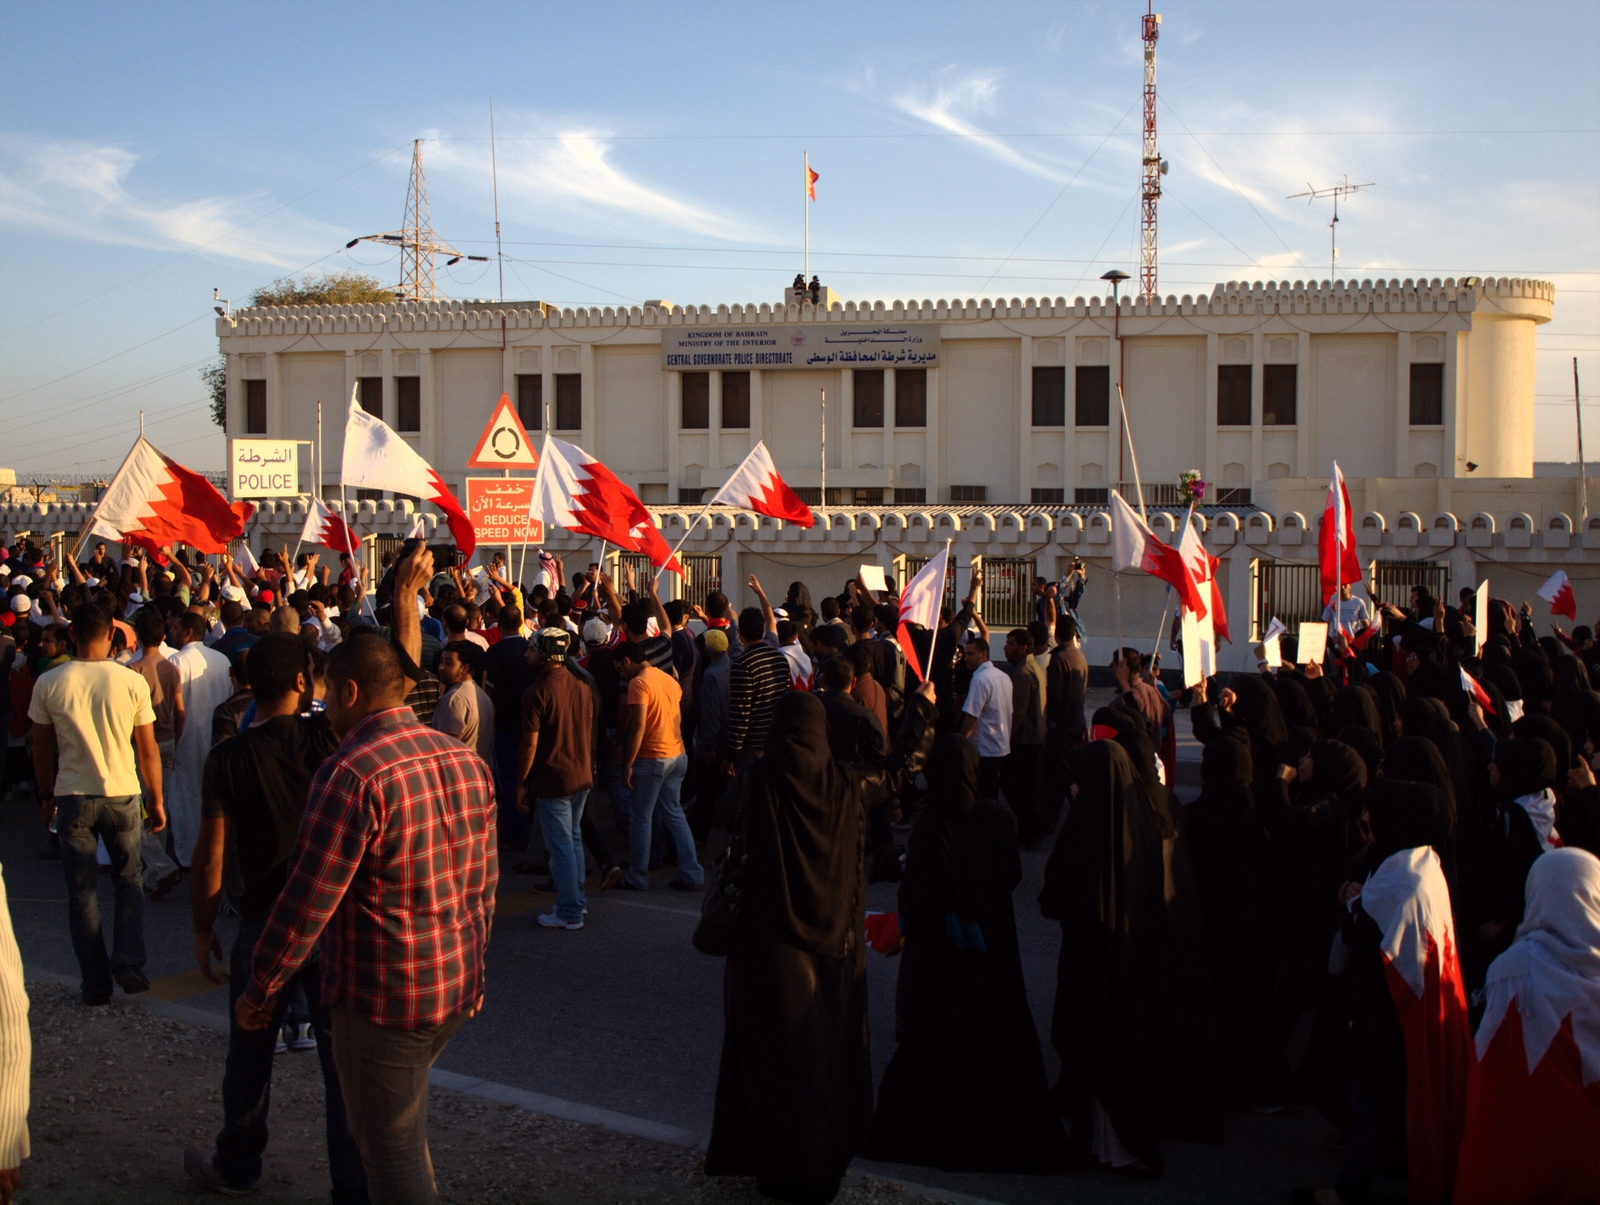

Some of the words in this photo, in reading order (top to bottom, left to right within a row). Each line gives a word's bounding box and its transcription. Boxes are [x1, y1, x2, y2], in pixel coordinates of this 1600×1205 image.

[840, 328, 882, 336] البحرين
[908, 336, 923, 344] وزارة
[667, 353, 691, 366] CENTRAL
[693, 353, 732, 366] GOVERNORATE
[734, 352, 753, 365] POLICE
[755, 352, 793, 365] DIRECTORATE
[806, 351, 838, 365] الوسطى
[839, 350, 880, 362] المحافظة
[882, 348, 906, 364] شرطة
[907, 348, 936, 364] مديرية
[238, 448, 292, 467] الشرطة
[238, 474, 292, 489] POLICE
[485, 483, 525, 494] خفف
[472, 495, 493, 512] الآن
[495, 497, 531, 512] سرعة
[484, 514, 528, 525] REDUCE
[474, 527, 509, 538] SPEED
[513, 527, 538, 538] NOW
